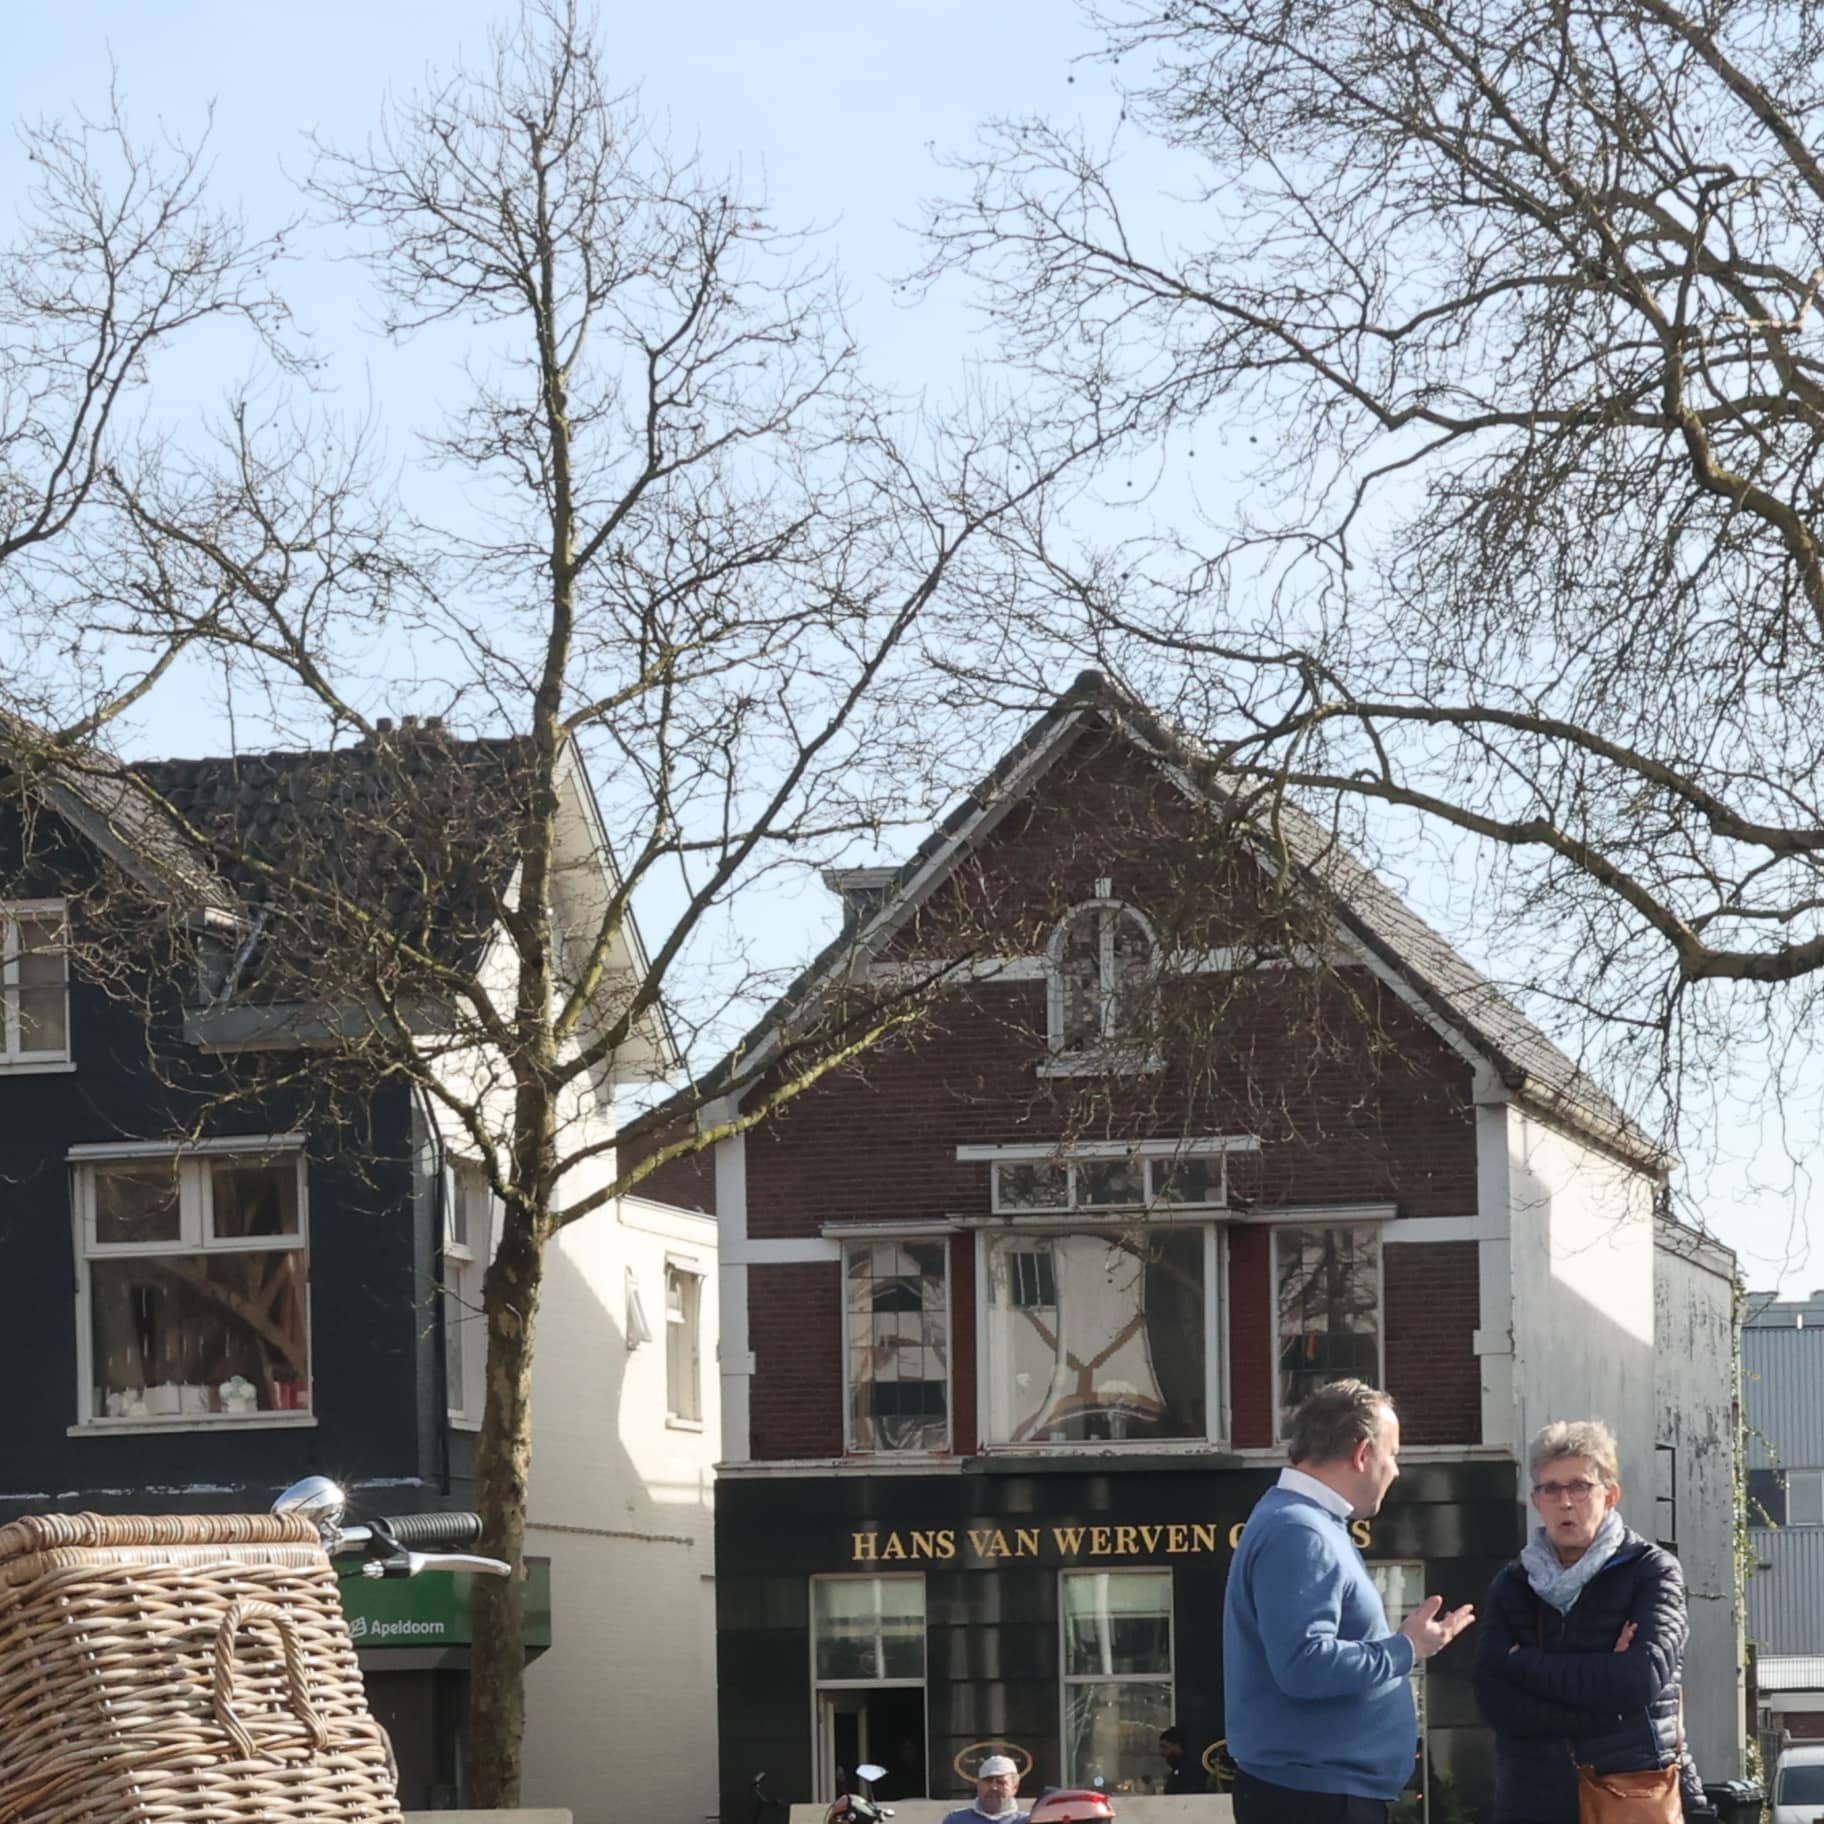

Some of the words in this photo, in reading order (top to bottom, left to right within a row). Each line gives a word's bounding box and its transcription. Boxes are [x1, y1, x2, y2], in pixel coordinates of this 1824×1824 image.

[851, 1530, 955, 1560] HANS
[968, 1528, 1040, 1558] VAN
[1052, 1524, 1216, 1556] WERVEN
[370, 1620, 445, 1638] Apeldoorn
